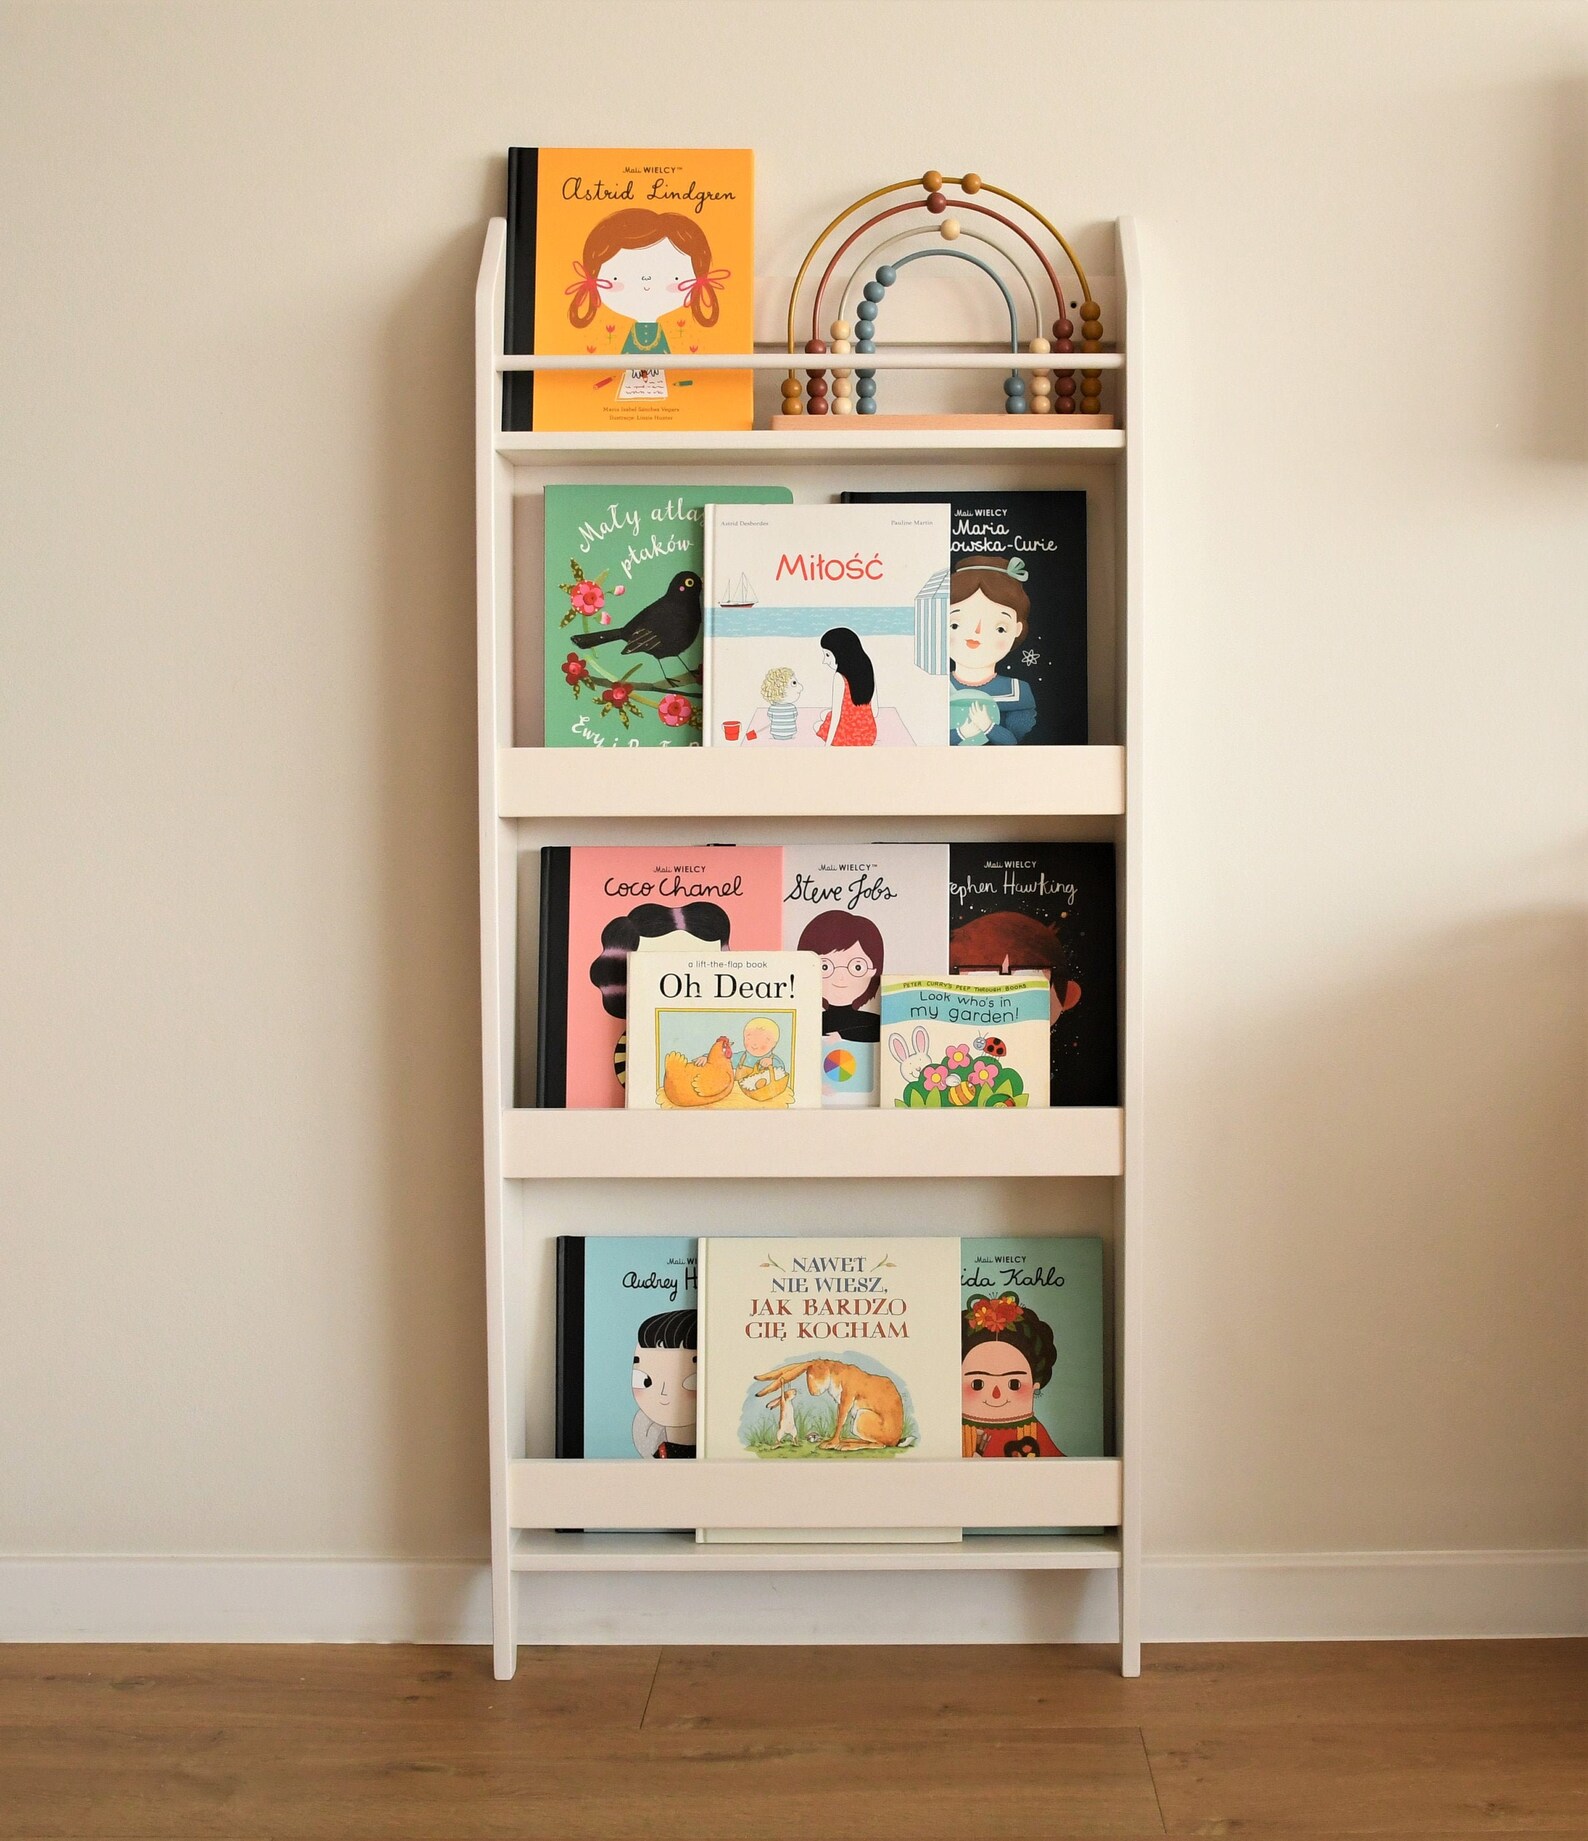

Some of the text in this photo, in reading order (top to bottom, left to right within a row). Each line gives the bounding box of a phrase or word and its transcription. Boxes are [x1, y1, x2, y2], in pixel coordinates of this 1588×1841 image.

[562, 177, 736, 214] Astrid Lindgren
[578, 503, 641, 553] Mały
[952, 519, 1010, 536] Maria
[950, 536, 1058, 552] owska-Curie
[620, 534, 694, 580] ptaków
[776, 552, 884, 581] Miłość
[1004, 860, 1037, 868] WIELCY
[604, 876, 744, 896] Coco Chanel
[784, 874, 898, 910] Steve Jobs
[950, 870, 1078, 906] ephen Hawking
[696, 960, 743, 969] lift-the-flap
[660, 973, 795, 998] Oh Dear!
[1005, 984, 1027, 992] BOOKS
[920, 992, 1012, 1008] Look who's in
[910, 1006, 1019, 1023] my garden!
[792, 1256, 866, 1272] NAWET
[771, 1277, 888, 1294] NIE WIESZ,
[961, 1266, 1065, 1286] ida Kahlo
[622, 1272, 678, 1302] Audrey
[750, 1298, 907, 1316] JAK BARDZO
[745, 1321, 910, 1341] CIĘ KOCHAM
